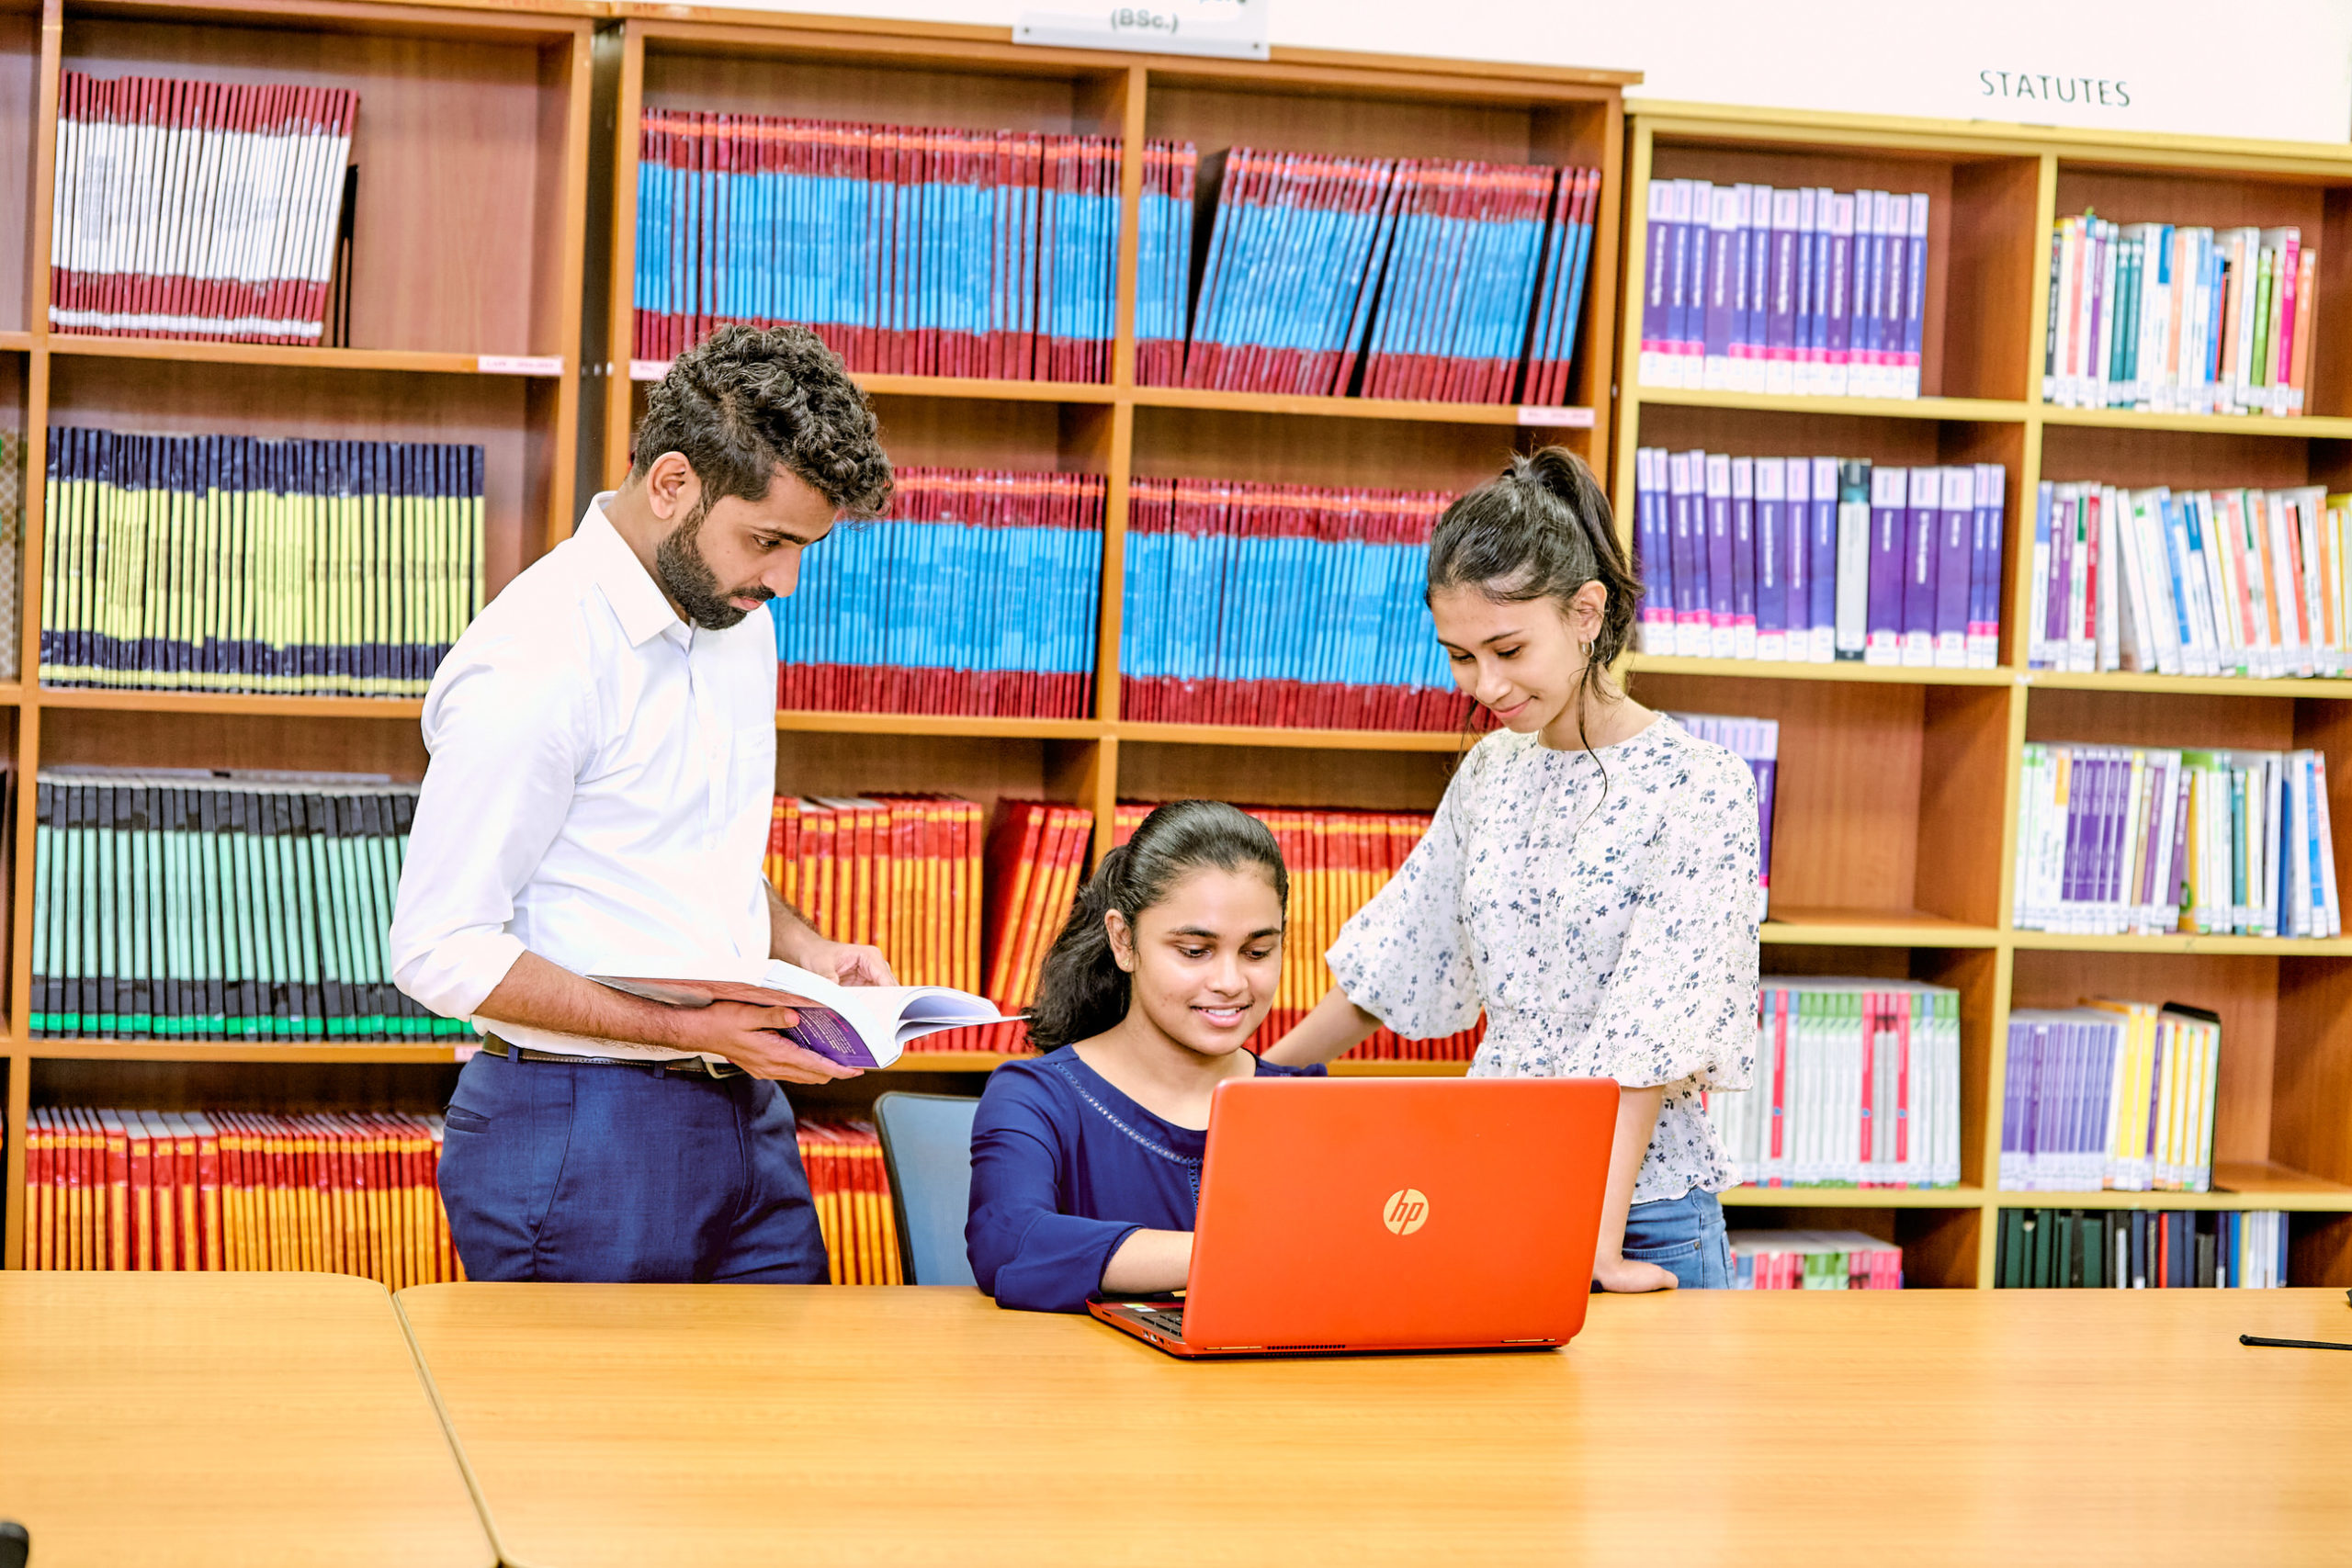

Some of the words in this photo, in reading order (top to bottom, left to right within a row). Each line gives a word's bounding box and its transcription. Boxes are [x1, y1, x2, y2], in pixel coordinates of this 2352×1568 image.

[1110, 7, 1180, 34] (BSc.)
[1979, 69, 2132, 108] STATUTES
[1385, 1189, 1427, 1235] hp
